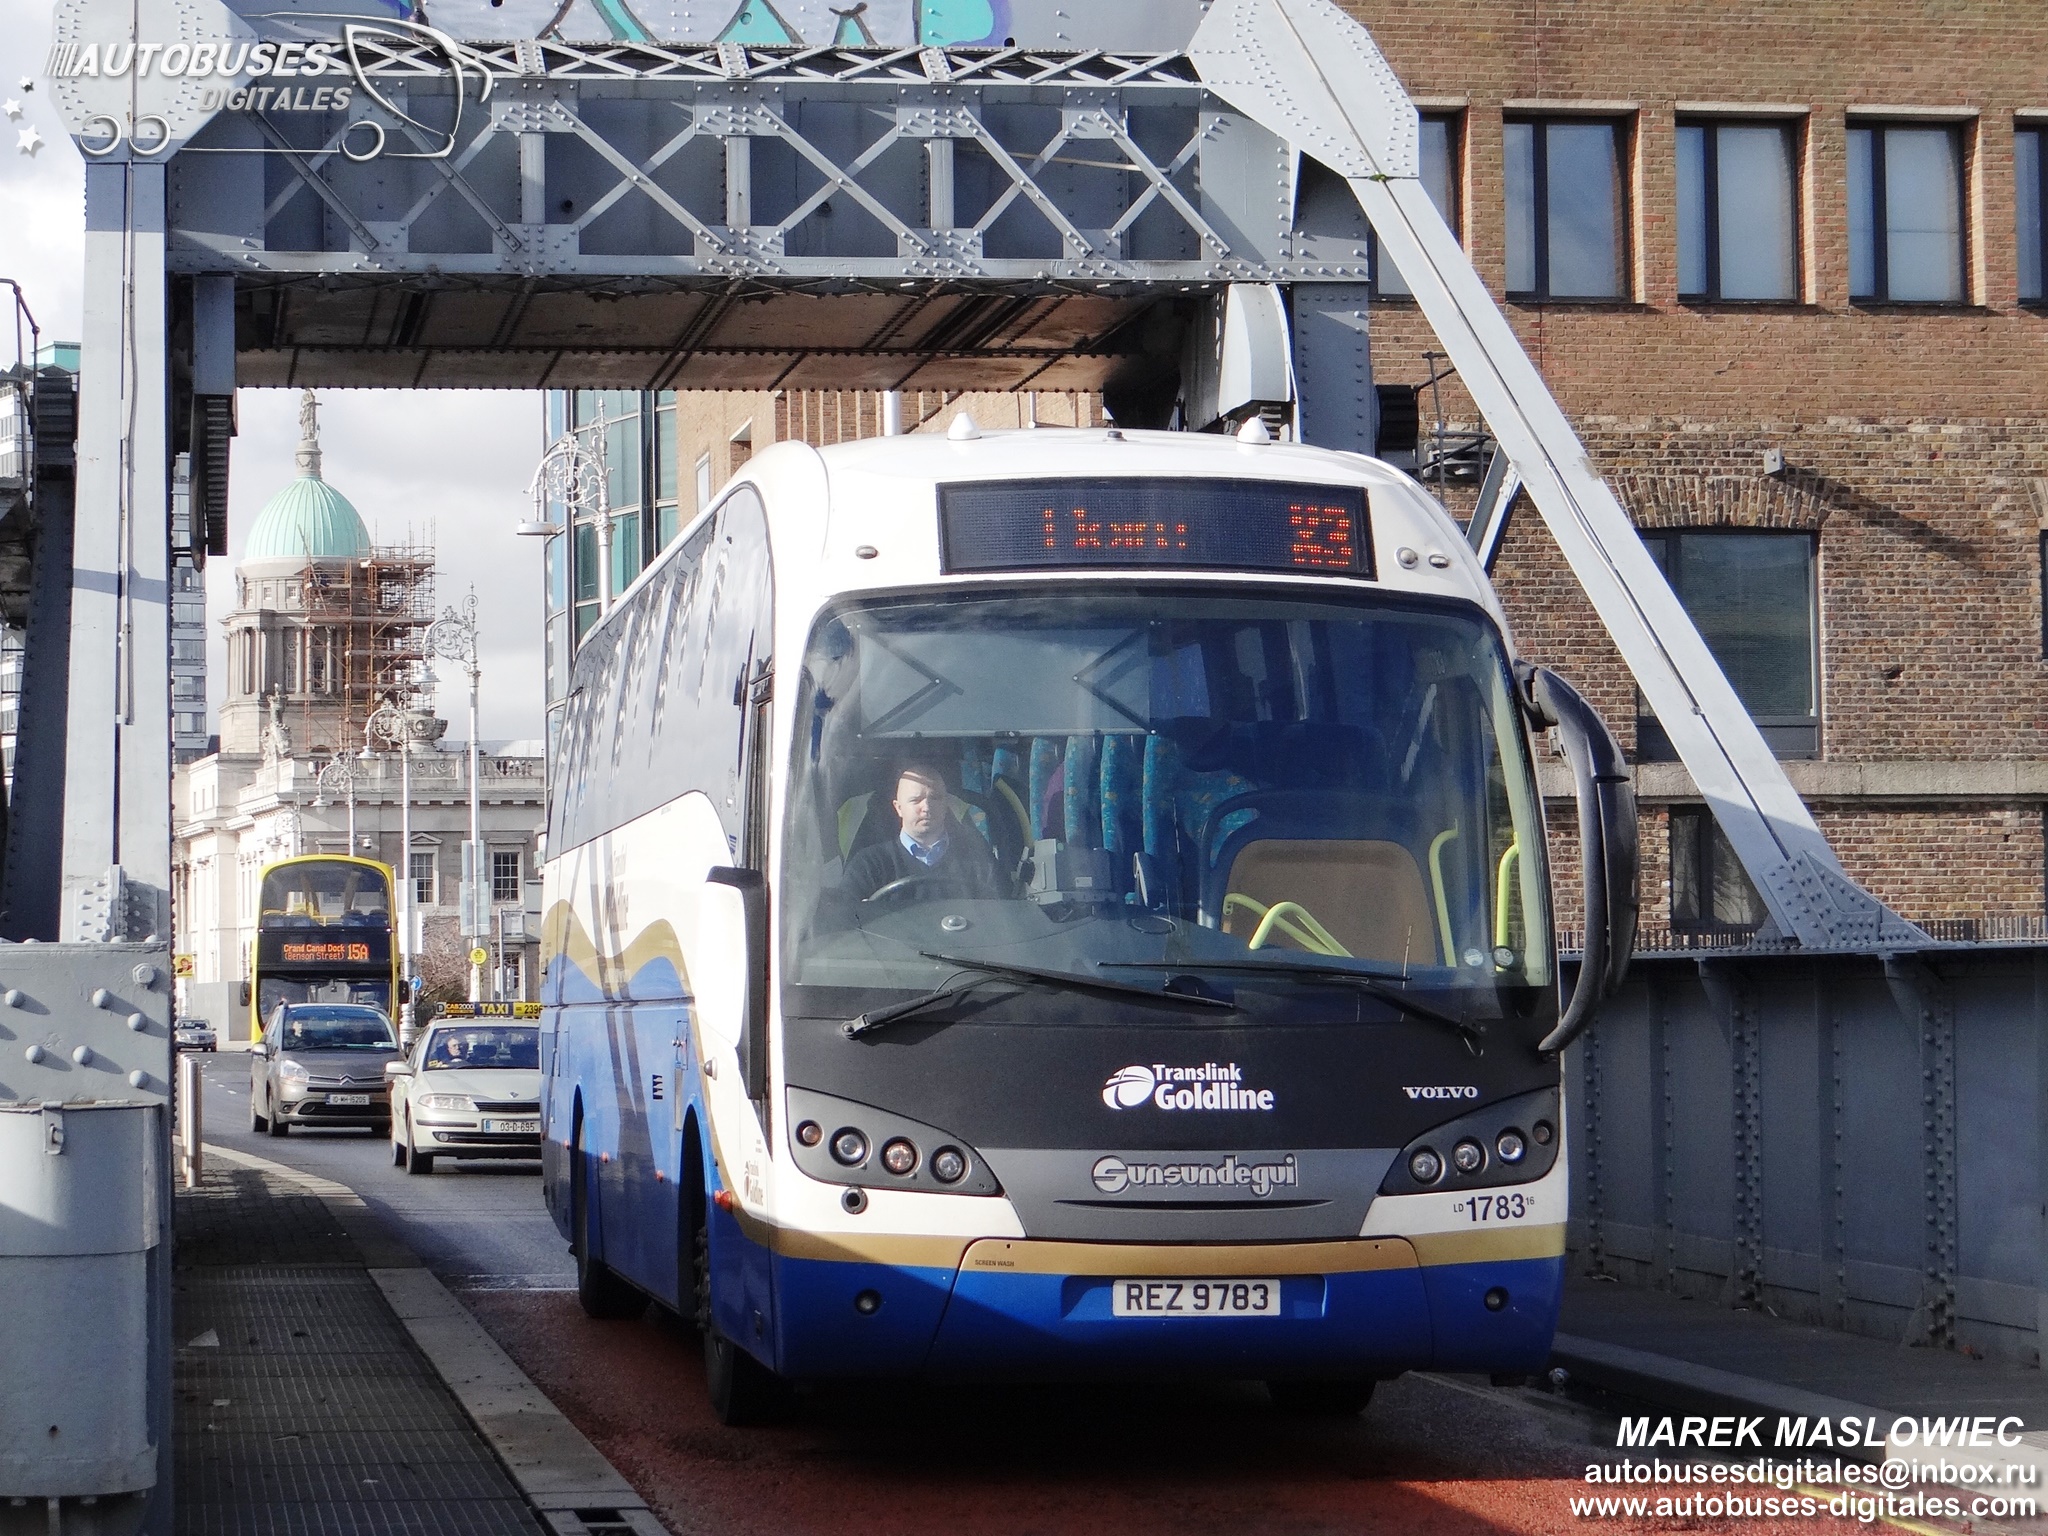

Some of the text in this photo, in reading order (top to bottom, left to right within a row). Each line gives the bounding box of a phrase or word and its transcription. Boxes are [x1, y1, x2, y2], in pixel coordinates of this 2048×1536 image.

[283, 944, 345, 952] Grand Canal Dock
[316, 952, 344, 960] Street)
[347, 943, 368, 960] 15A
[480, 1004, 508, 1014] TAXI
[1153, 1063, 1242, 1081] Translink
[1154, 1082, 1275, 1110] Goldline
[1402, 1086, 1479, 1099] VOLVO
[1092, 1154, 1298, 1198] Sunsundegui
[1453, 1203, 1464, 1213] LD
[1466, 1193, 1526, 1221] 1783
[1126, 1283, 1270, 1311] REZ 9783
